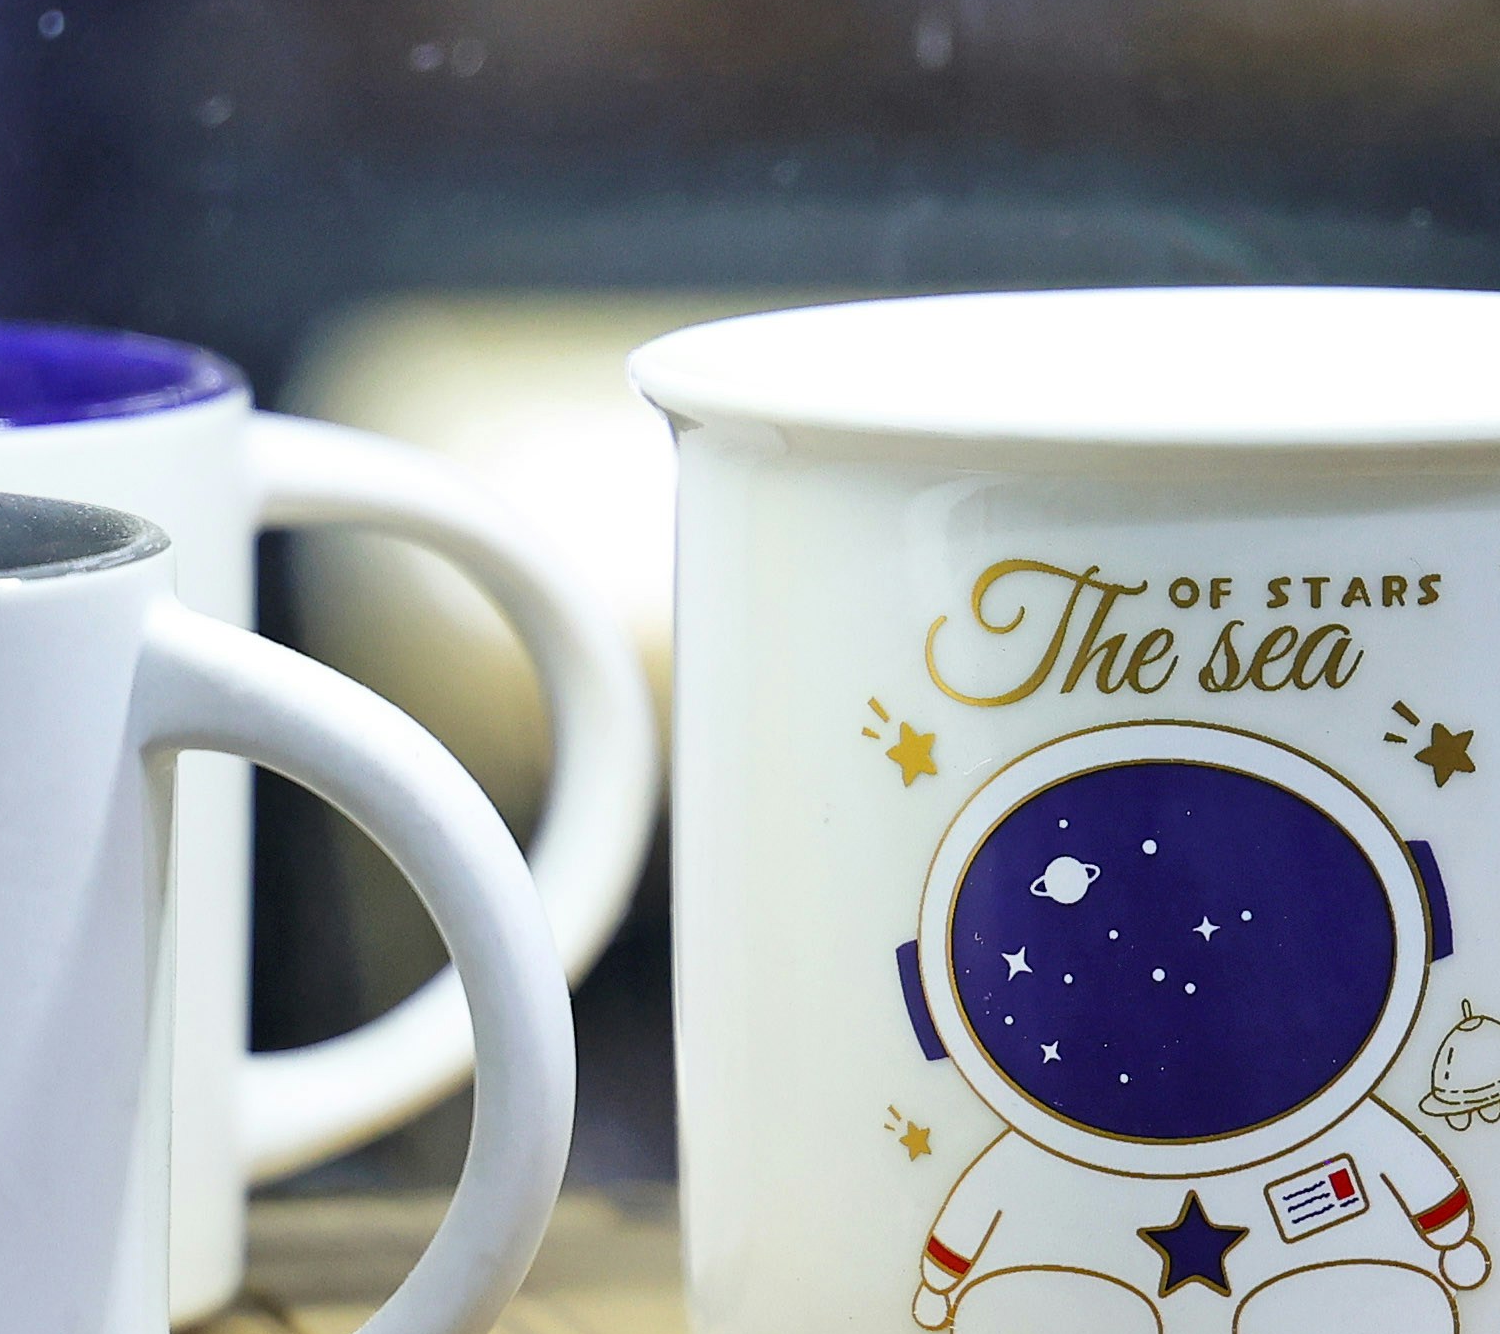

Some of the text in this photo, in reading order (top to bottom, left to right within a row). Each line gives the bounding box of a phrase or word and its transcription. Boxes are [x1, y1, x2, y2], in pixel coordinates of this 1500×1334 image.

[924, 558, 1365, 707] The sea
[1168, 573, 1443, 610] OF STARS
